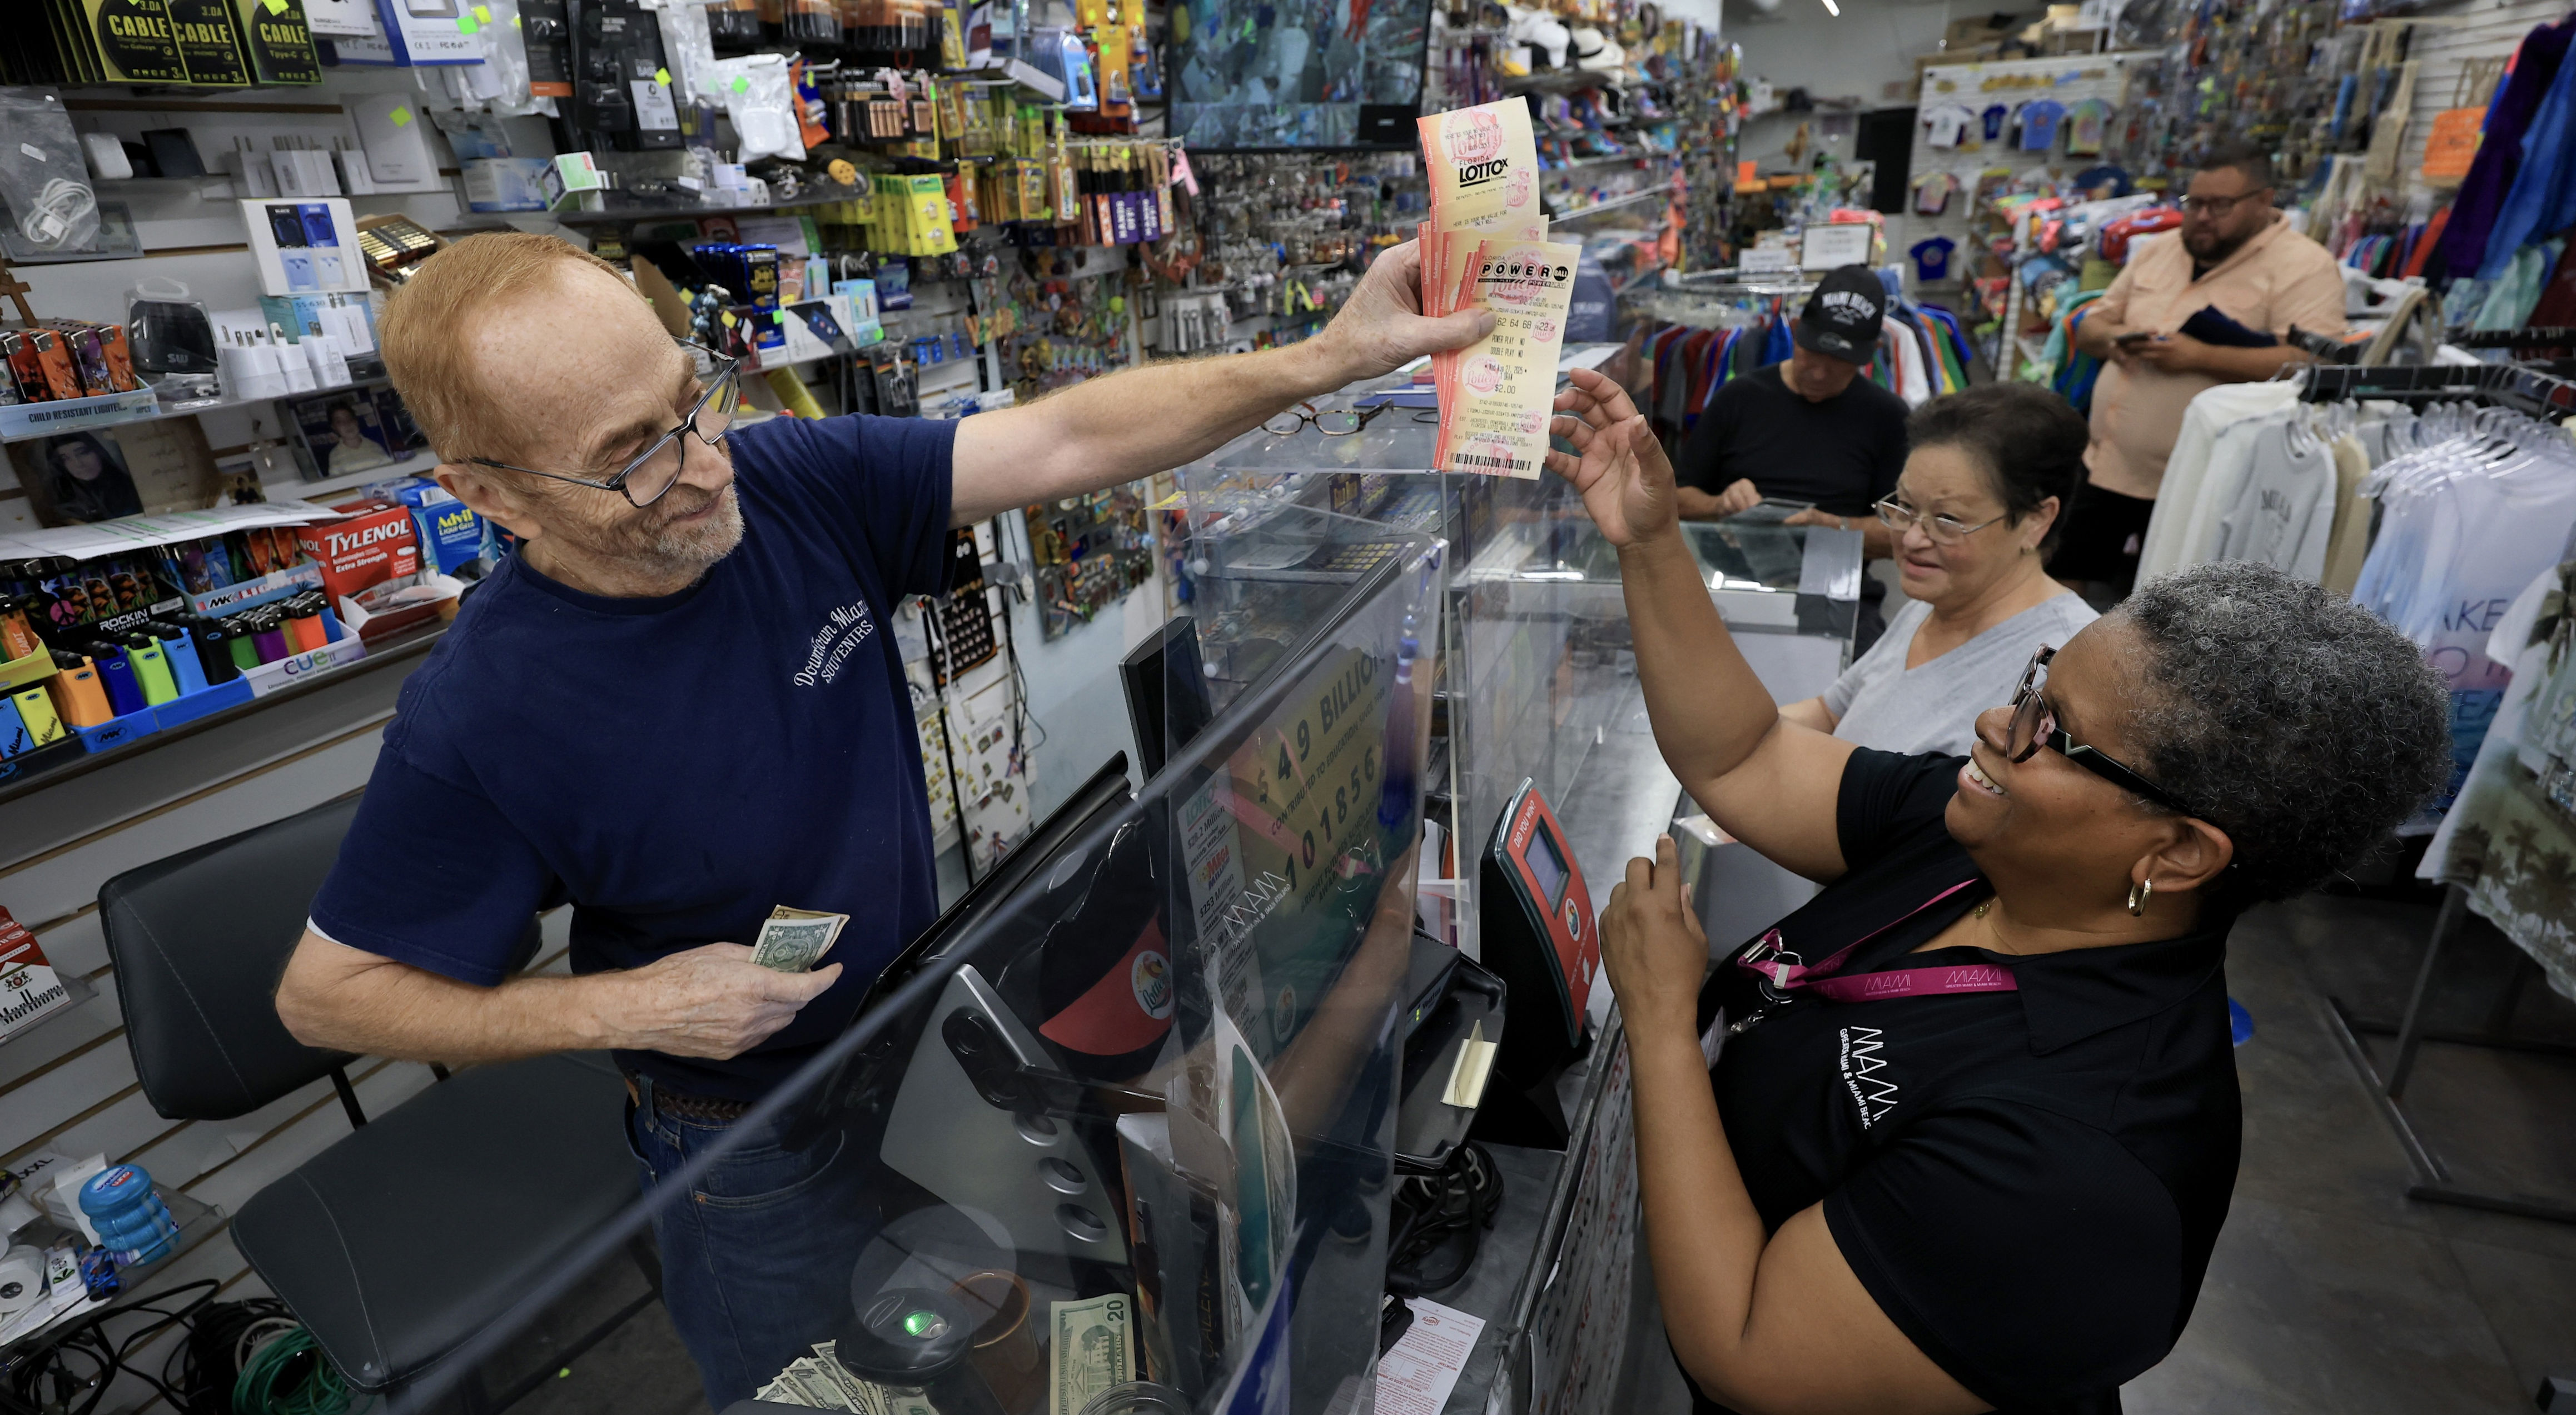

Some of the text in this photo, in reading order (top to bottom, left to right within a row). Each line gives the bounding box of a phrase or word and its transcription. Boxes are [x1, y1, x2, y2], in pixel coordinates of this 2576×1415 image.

[108, 14, 170, 38] CABLE
[173, 22, 231, 44] CABLE
[259, 23, 308, 44] CABLE
[1459, 155, 1490, 167] FLORIDA
[1821, 291, 1878, 321] MIAMI BEACH
[1497, 317, 1532, 329] 62 64 68
[1491, 334, 1525, 346] POWER PLAY NO
[1490, 346, 1523, 358] DOUBLE PLAY NO
[1494, 383, 1516, 394] $2.00
[28, 406, 92, 423] CHILD RESISTANT
[437, 508, 474, 530] Advil
[324, 519, 410, 557] TYLENOL
[335, 561, 356, 574] Extra
[356, 551, 389, 567] Strength
[98, 608, 149, 632] ROCKIN
[113, 616, 150, 632] LIGHTERS
[13, 631, 32, 657] IAMI
[820, 619, 874, 684] SOUVENIRS
[1271, 773, 1316, 836] CONTRIBUTED
[1316, 761, 1326, 779] TO
[1326, 721, 1359, 768] EDUCATION
[1514, 800, 1537, 848] DID YOU WIN?
[1200, 896, 1214, 919] $253
[1864, 974, 1911, 992] MIAMI
[1945, 968, 2002, 984] MIAMI
[1843, 1071, 1853, 1080] &
[1846, 1079, 1867, 1107] MIAMI
[1859, 1105, 1872, 1130] BEAC
[1107, 1299, 1124, 1322] 20
